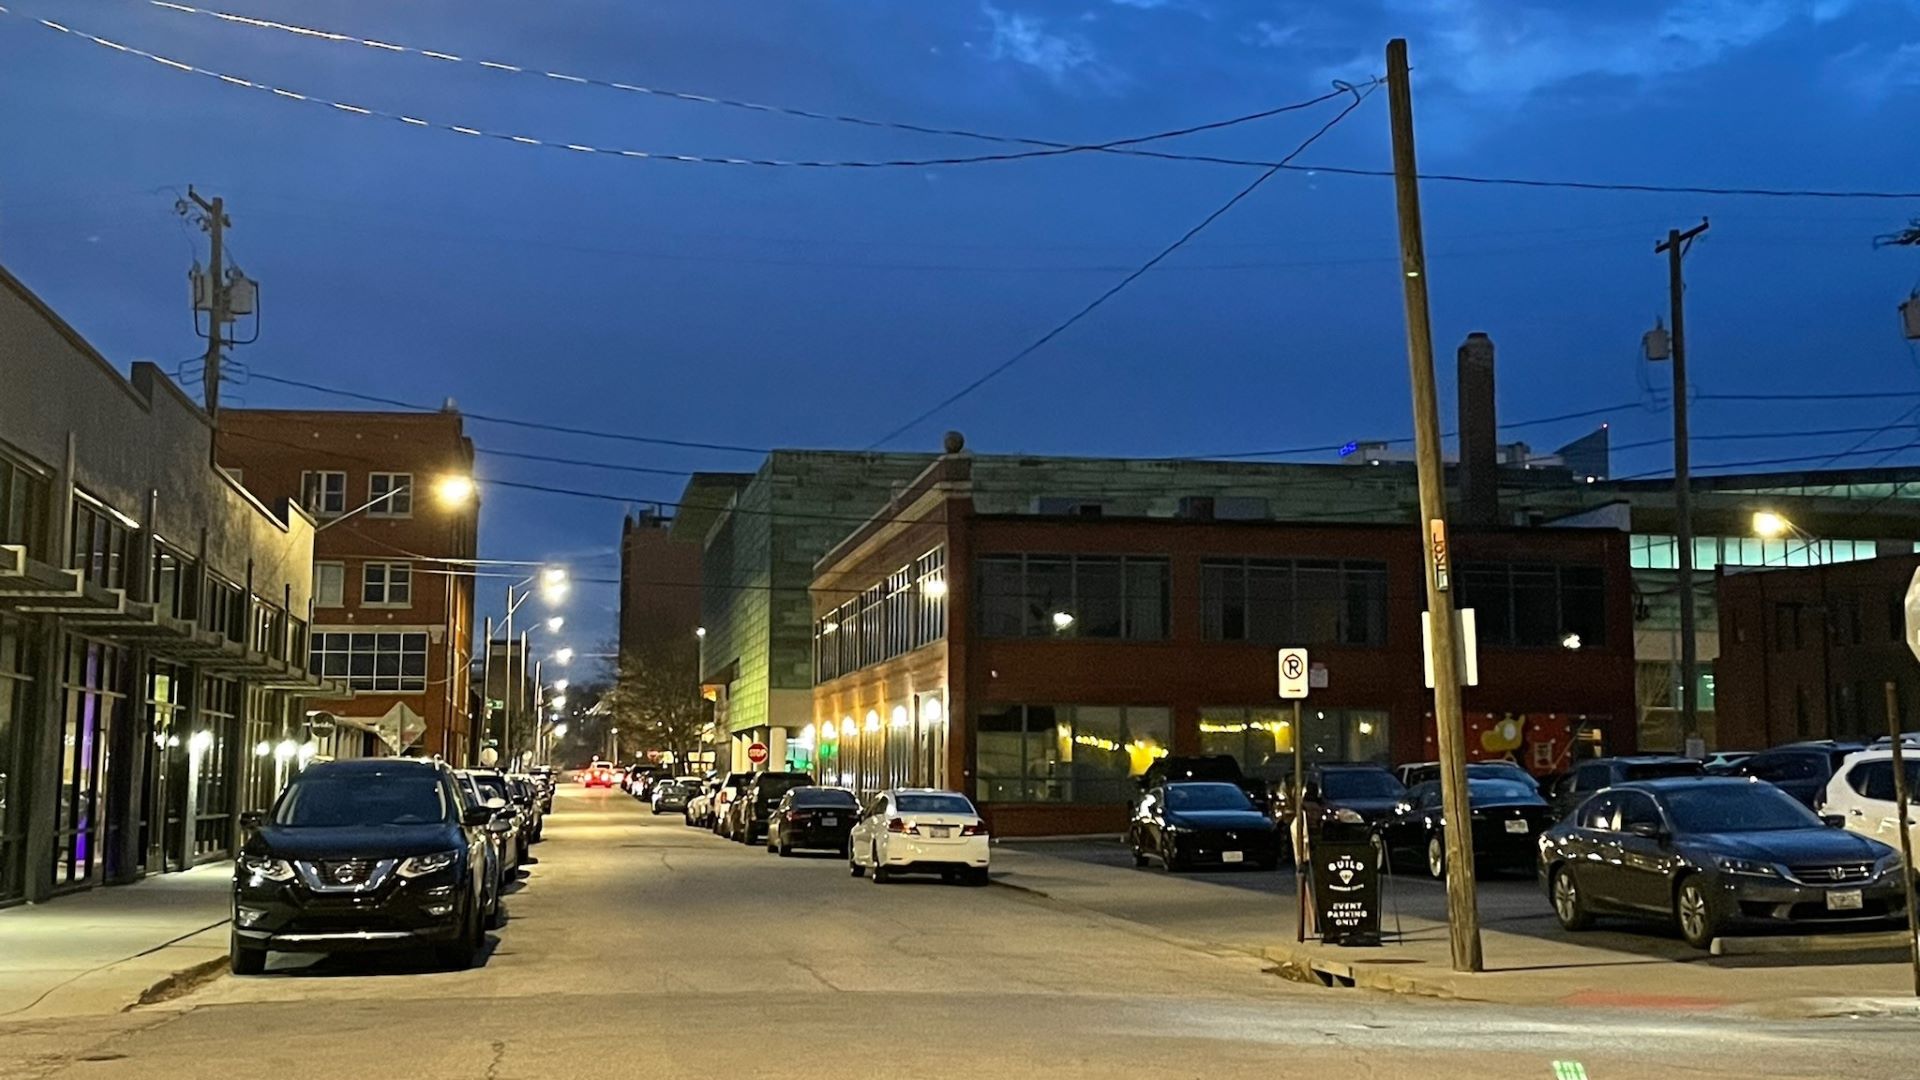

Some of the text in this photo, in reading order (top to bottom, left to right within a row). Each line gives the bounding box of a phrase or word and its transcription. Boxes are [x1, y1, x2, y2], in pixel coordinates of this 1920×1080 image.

[750, 748, 767, 757] STOP
[1328, 860, 1364, 871] GUILD
[1333, 902, 1362, 910] EVENT
[1327, 910, 1368, 918] PARKING
[1335, 918, 1359, 926] ONLY
